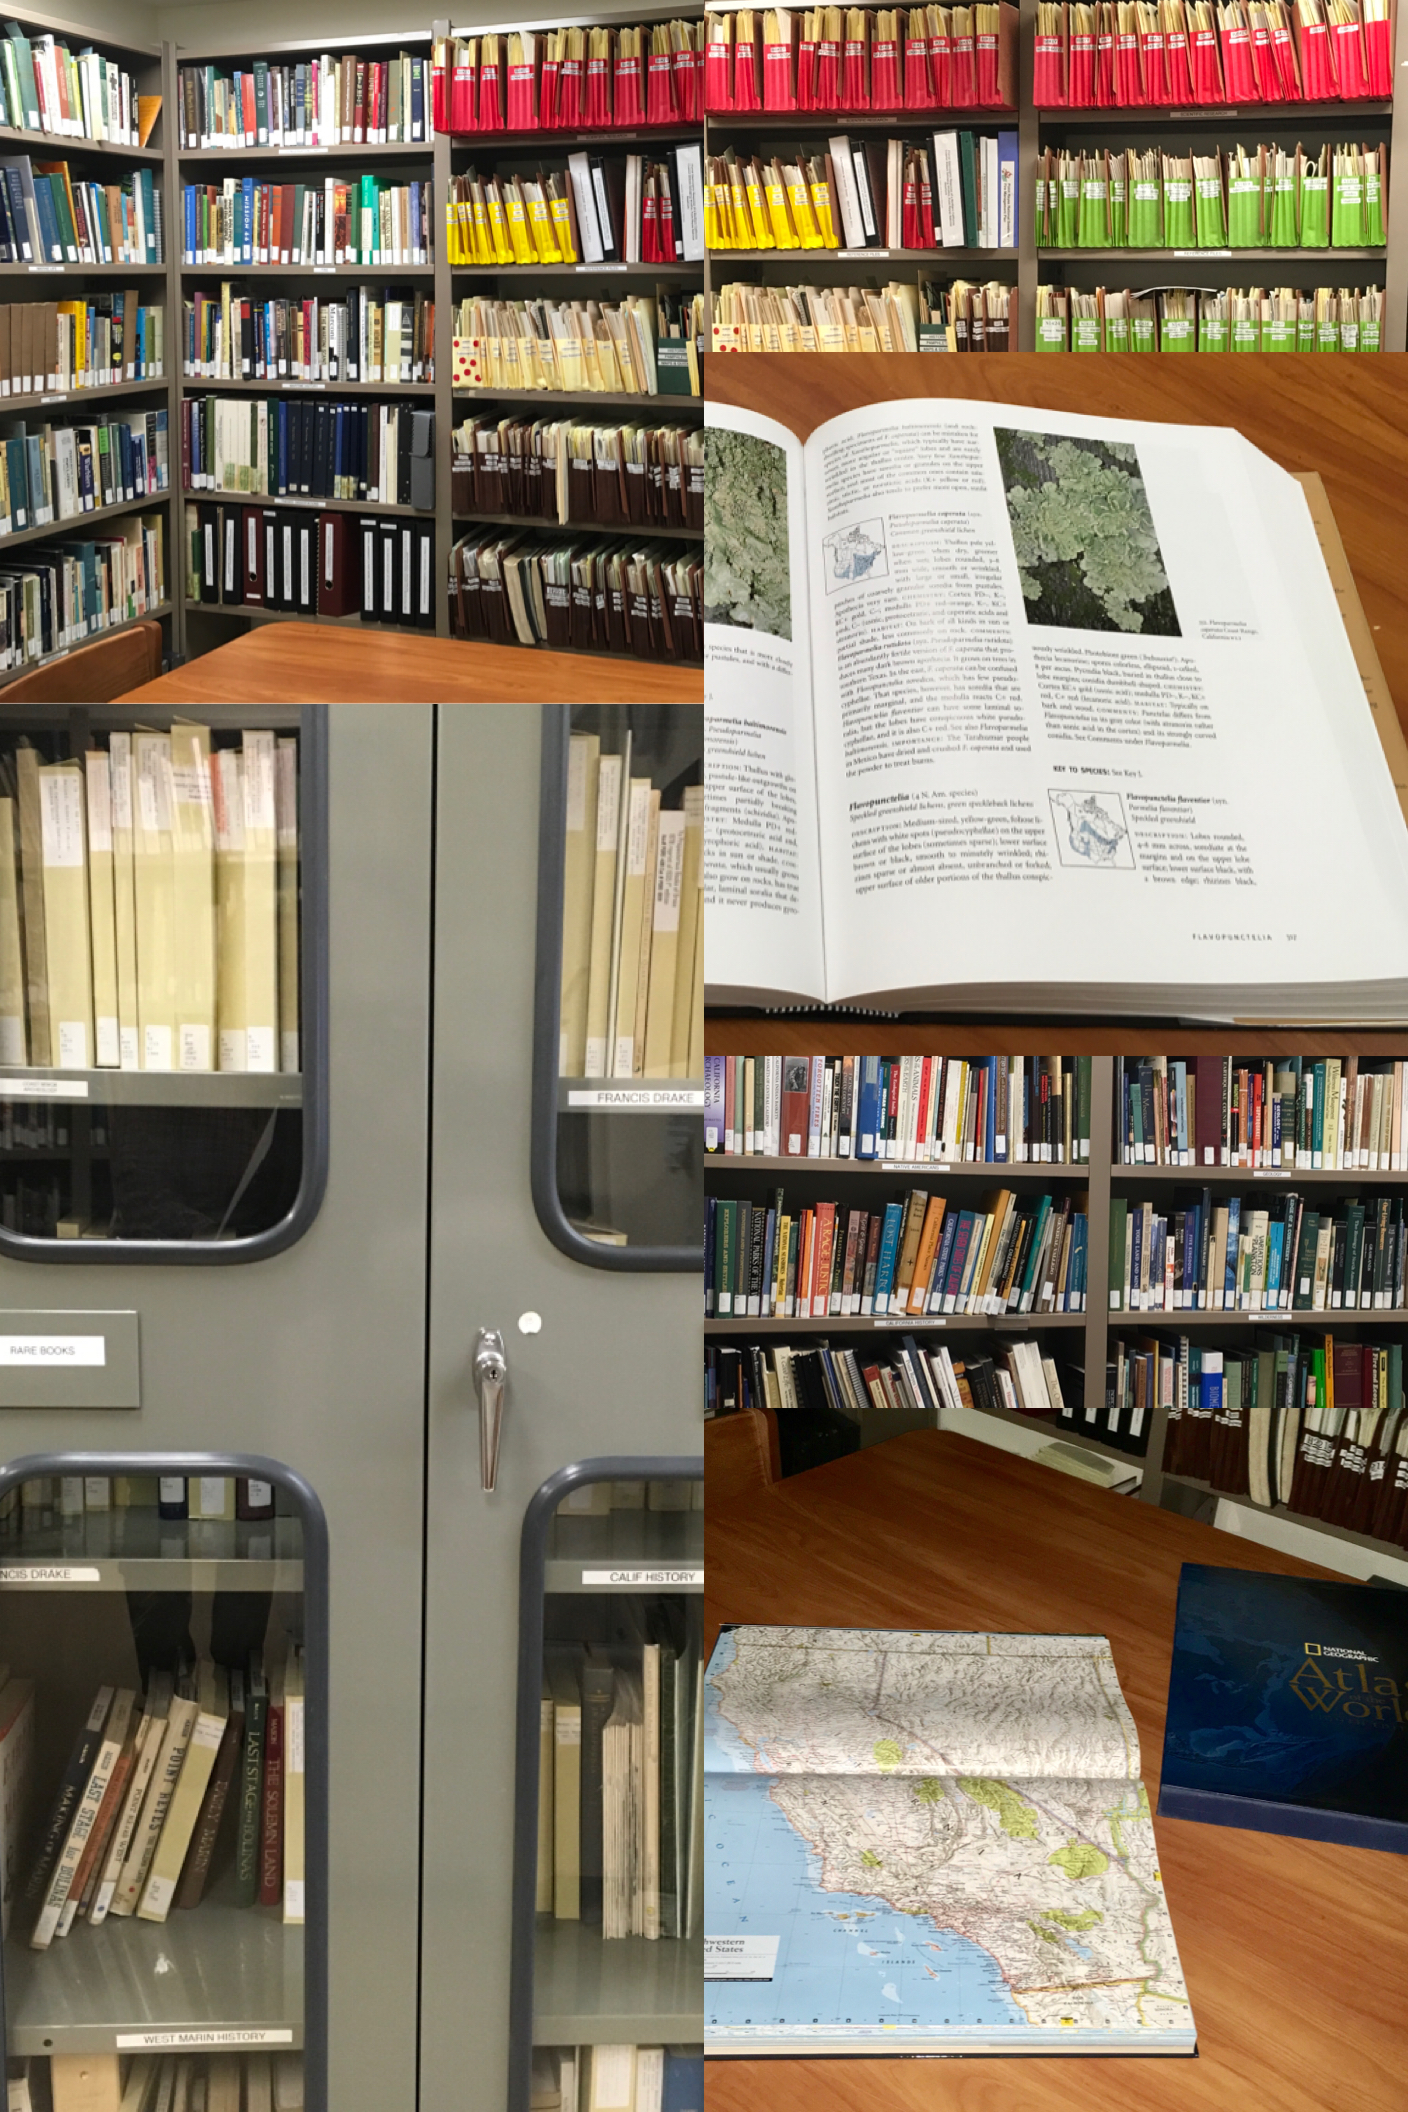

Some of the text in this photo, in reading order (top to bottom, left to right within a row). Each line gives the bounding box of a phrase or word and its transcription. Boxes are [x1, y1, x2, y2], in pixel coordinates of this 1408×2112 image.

[949, 788, 978, 798] species)
[902, 1072, 910, 1093] EARTH
[911, 1069, 920, 1100] ANIMALS
[1330, 1066, 1340, 1120] Wilderness Management
[597, 1092, 694, 1104] FRANCIS DRAKE
[754, 1212, 762, 1244] NATIONAL
[822, 1218, 832, 1258] A RAGE
[884, 1219, 896, 1247] LOST
[930, 1216, 939, 1240] California
[926, 1241, 935, 1253] Place
[937, 1218, 955, 1277] CALIFORNIA STATE PARKS
[951, 1220, 972, 1274] THE SEVEN STATES OF
[1002, 1215, 1022, 1278] CALIFORNIA DREAMING
[1050, 1217, 1062, 1275] GENERAL VALLEJO
[1250, 1238, 1258, 1276] PLANKTON
[1256, 1235, 1265, 1276] VARIATIONS
[752, 1266, 758, 1275] OF
[10, 1346, 76, 1356] RARE BOOKS
[781, 1360, 790, 1389] Good Life
[0, 1569, 72, 1578] NCIS DRAKE
[610, 1571, 696, 1582] CALIF HISTORY
[1323, 1646, 1368, 1656] NATIONAL
[1323, 1650, 1380, 1662] GEOGRAPHIC
[162, 1747, 185, 1784] POINT
[47, 1785, 76, 1840] MAKING
[129, 1788, 144, 1814] POINT
[241, 1731, 260, 1880] LAST STAGE BOLINAS
[264, 1759, 280, 1888] THE SOLEMN LAND
[46, 1775, 108, 1908] LAST STAGE BOLINAS
[144, 2032, 266, 2044] WEST MARIN HISTORY
